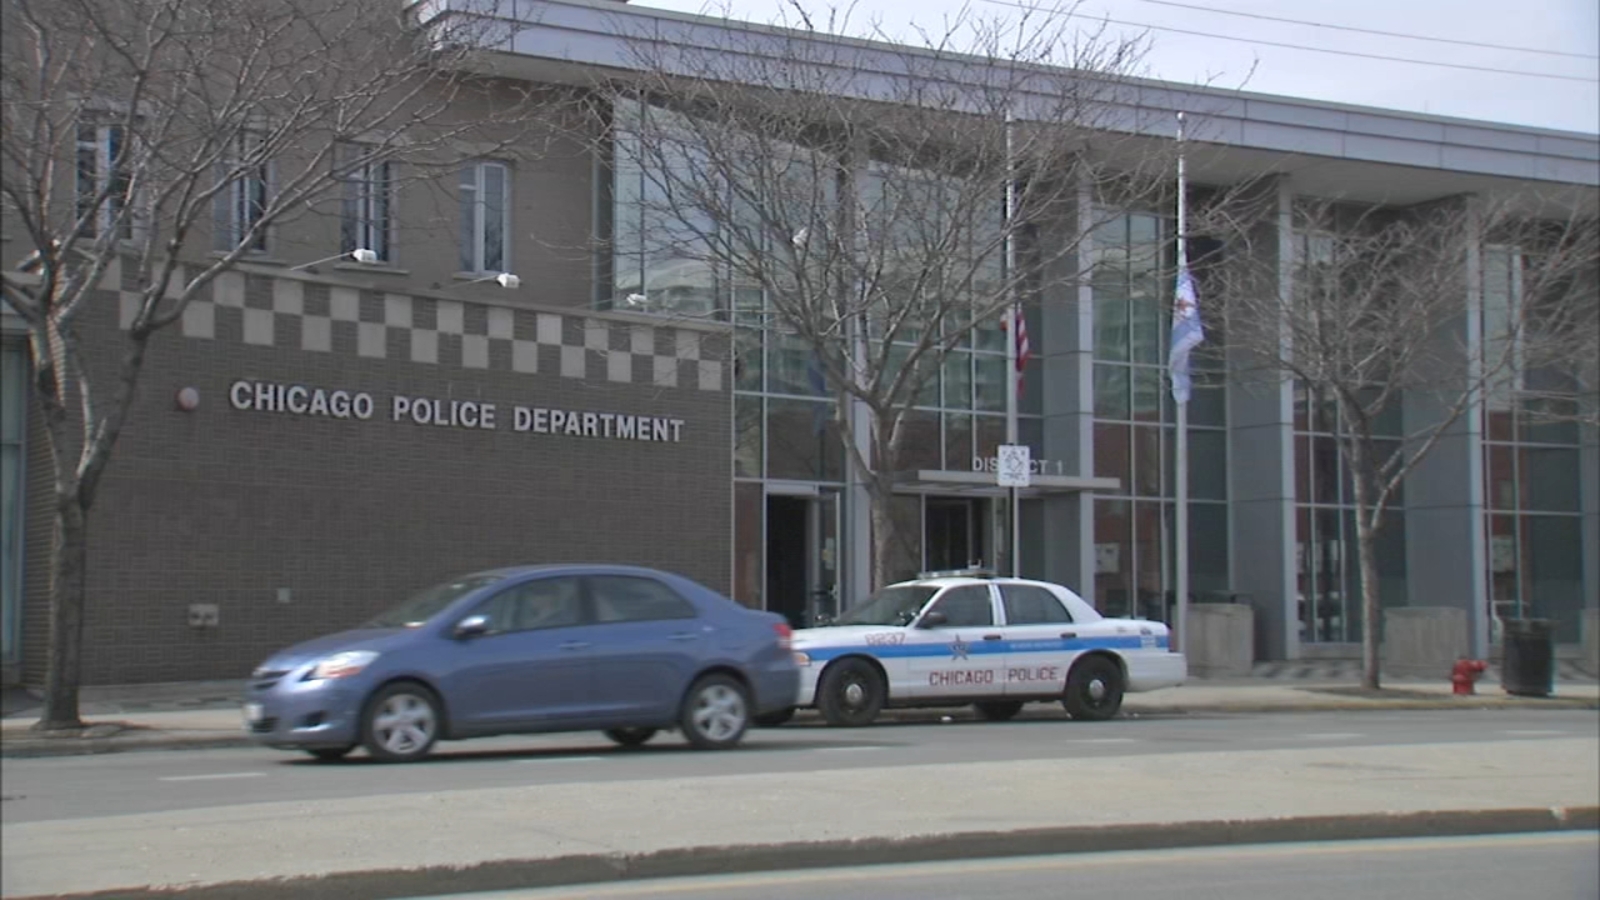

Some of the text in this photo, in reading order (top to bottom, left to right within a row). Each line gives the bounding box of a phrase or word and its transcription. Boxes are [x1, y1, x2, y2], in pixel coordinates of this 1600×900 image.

[229, 380, 686, 442] CHICAGO POLICE DEPARTMENT
[972, 456, 1063, 474] DISCT 1
[929, 666, 1058, 686] CHICAGO POLICE
